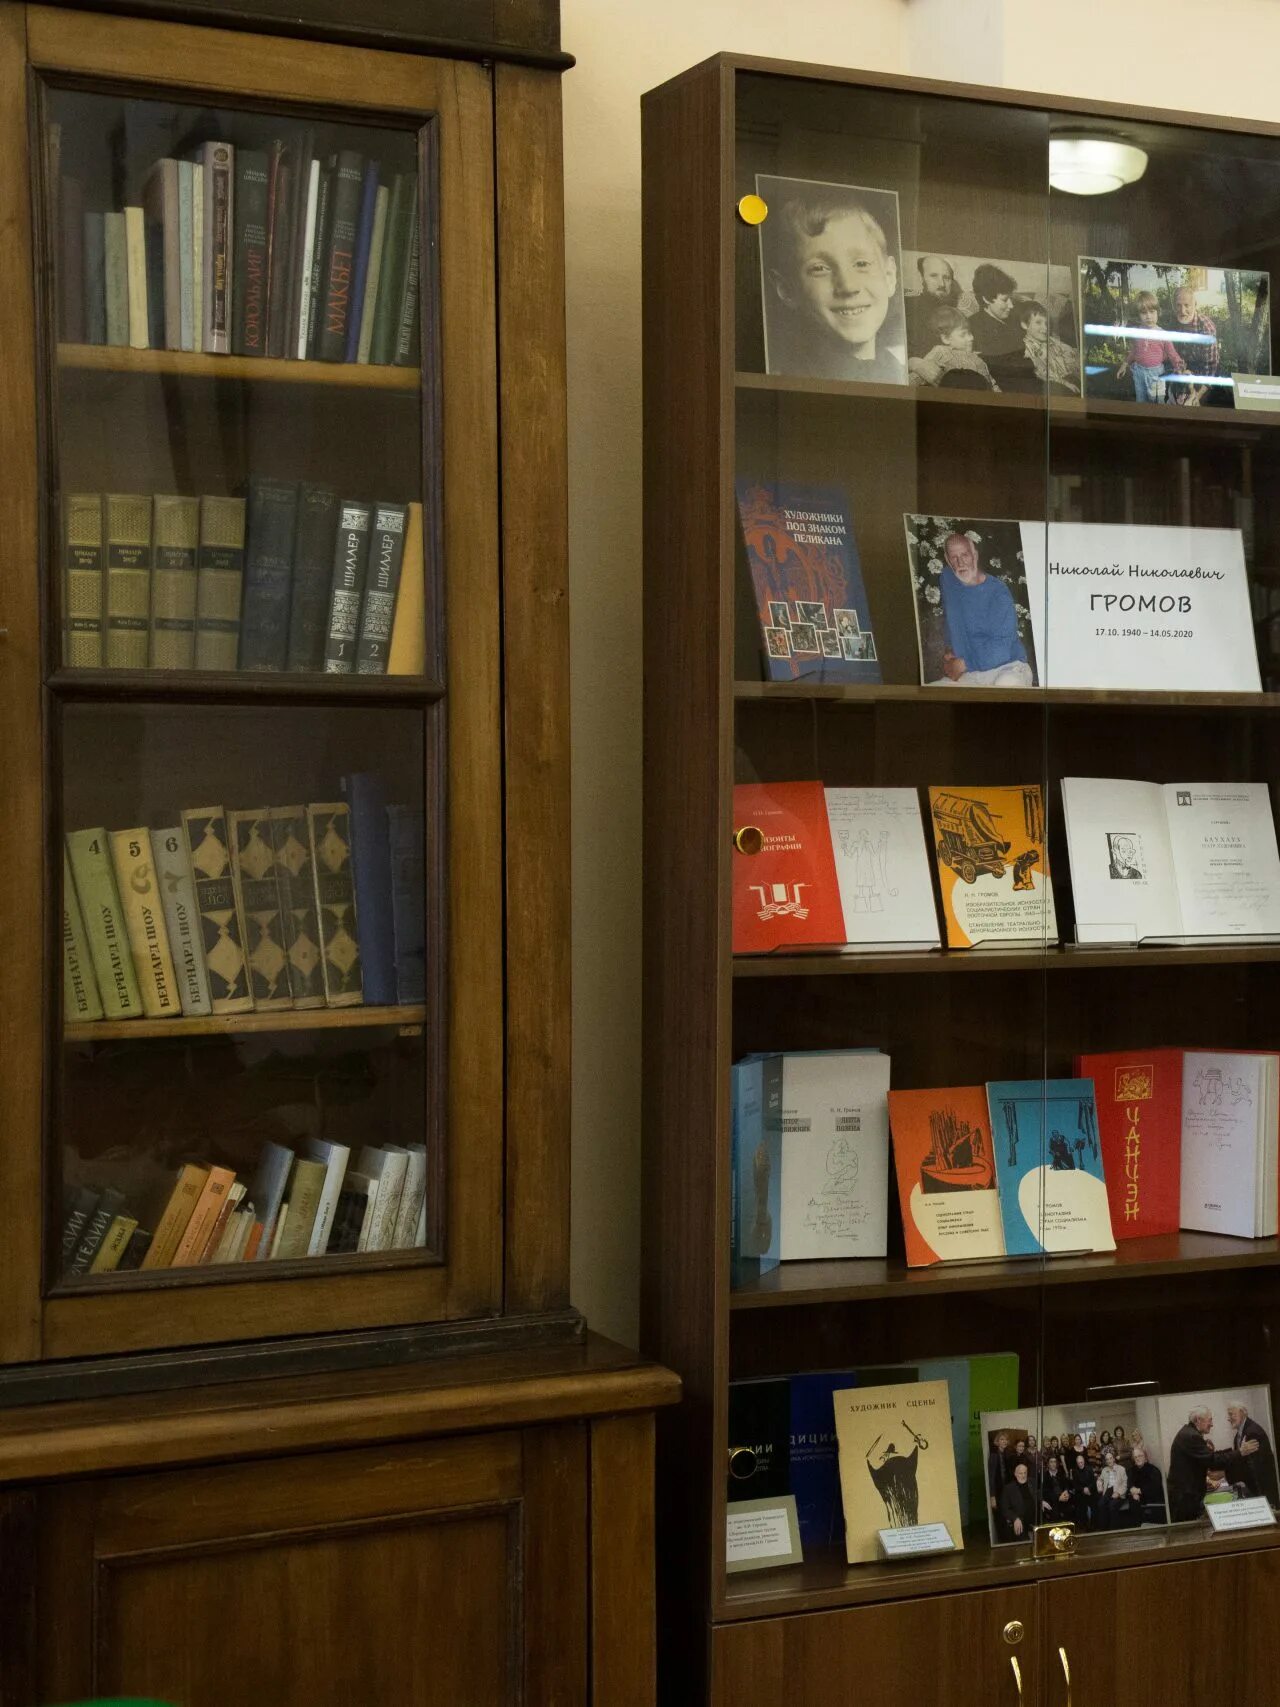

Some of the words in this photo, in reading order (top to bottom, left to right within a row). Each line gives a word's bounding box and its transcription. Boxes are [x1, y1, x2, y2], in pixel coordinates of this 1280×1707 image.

[326, 246, 353, 335] МАКБЕТ
[784, 510, 844, 523] ХУДОЖНИКИ
[786, 521, 806, 532] ПОД
[807, 523, 846, 534] ЗНАКОМ
[794, 533, 844, 546] ПЕЛИКАНА
[344, 533, 360, 587] ШИЛЛЕР
[377, 534, 394, 588] ШИЛЛЕР
[1049, 562, 1124, 577] Николай
[1128, 564, 1226, 580] Николаевич
[1090, 594, 1192, 613] ГРОМОВ
[1122, 629, 1141, 637] 1940
[1150, 629, 1193, 638] 14.05.2020
[338, 643, 344, 657] 1
[370, 644, 379, 657] 2
[89, 839, 101, 855] 4
[165, 837, 179, 852] 6
[763, 835, 796, 843] ИЗОНТЫ
[129, 841, 141, 857] 5
[100, 904, 116, 940] ШОУ
[142, 905, 157, 940] ШОУ
[176, 902, 190, 939] ШОУ
[108, 942, 130, 1009] БЕРНАРД
[149, 942, 170, 1008] БЕРНАРД
[183, 941, 202, 1004] БЕРНАРД
[850, 1401, 897, 1413] ХУДОЖНИК
[906, 1399, 936, 1408] СЦЕНЫ
